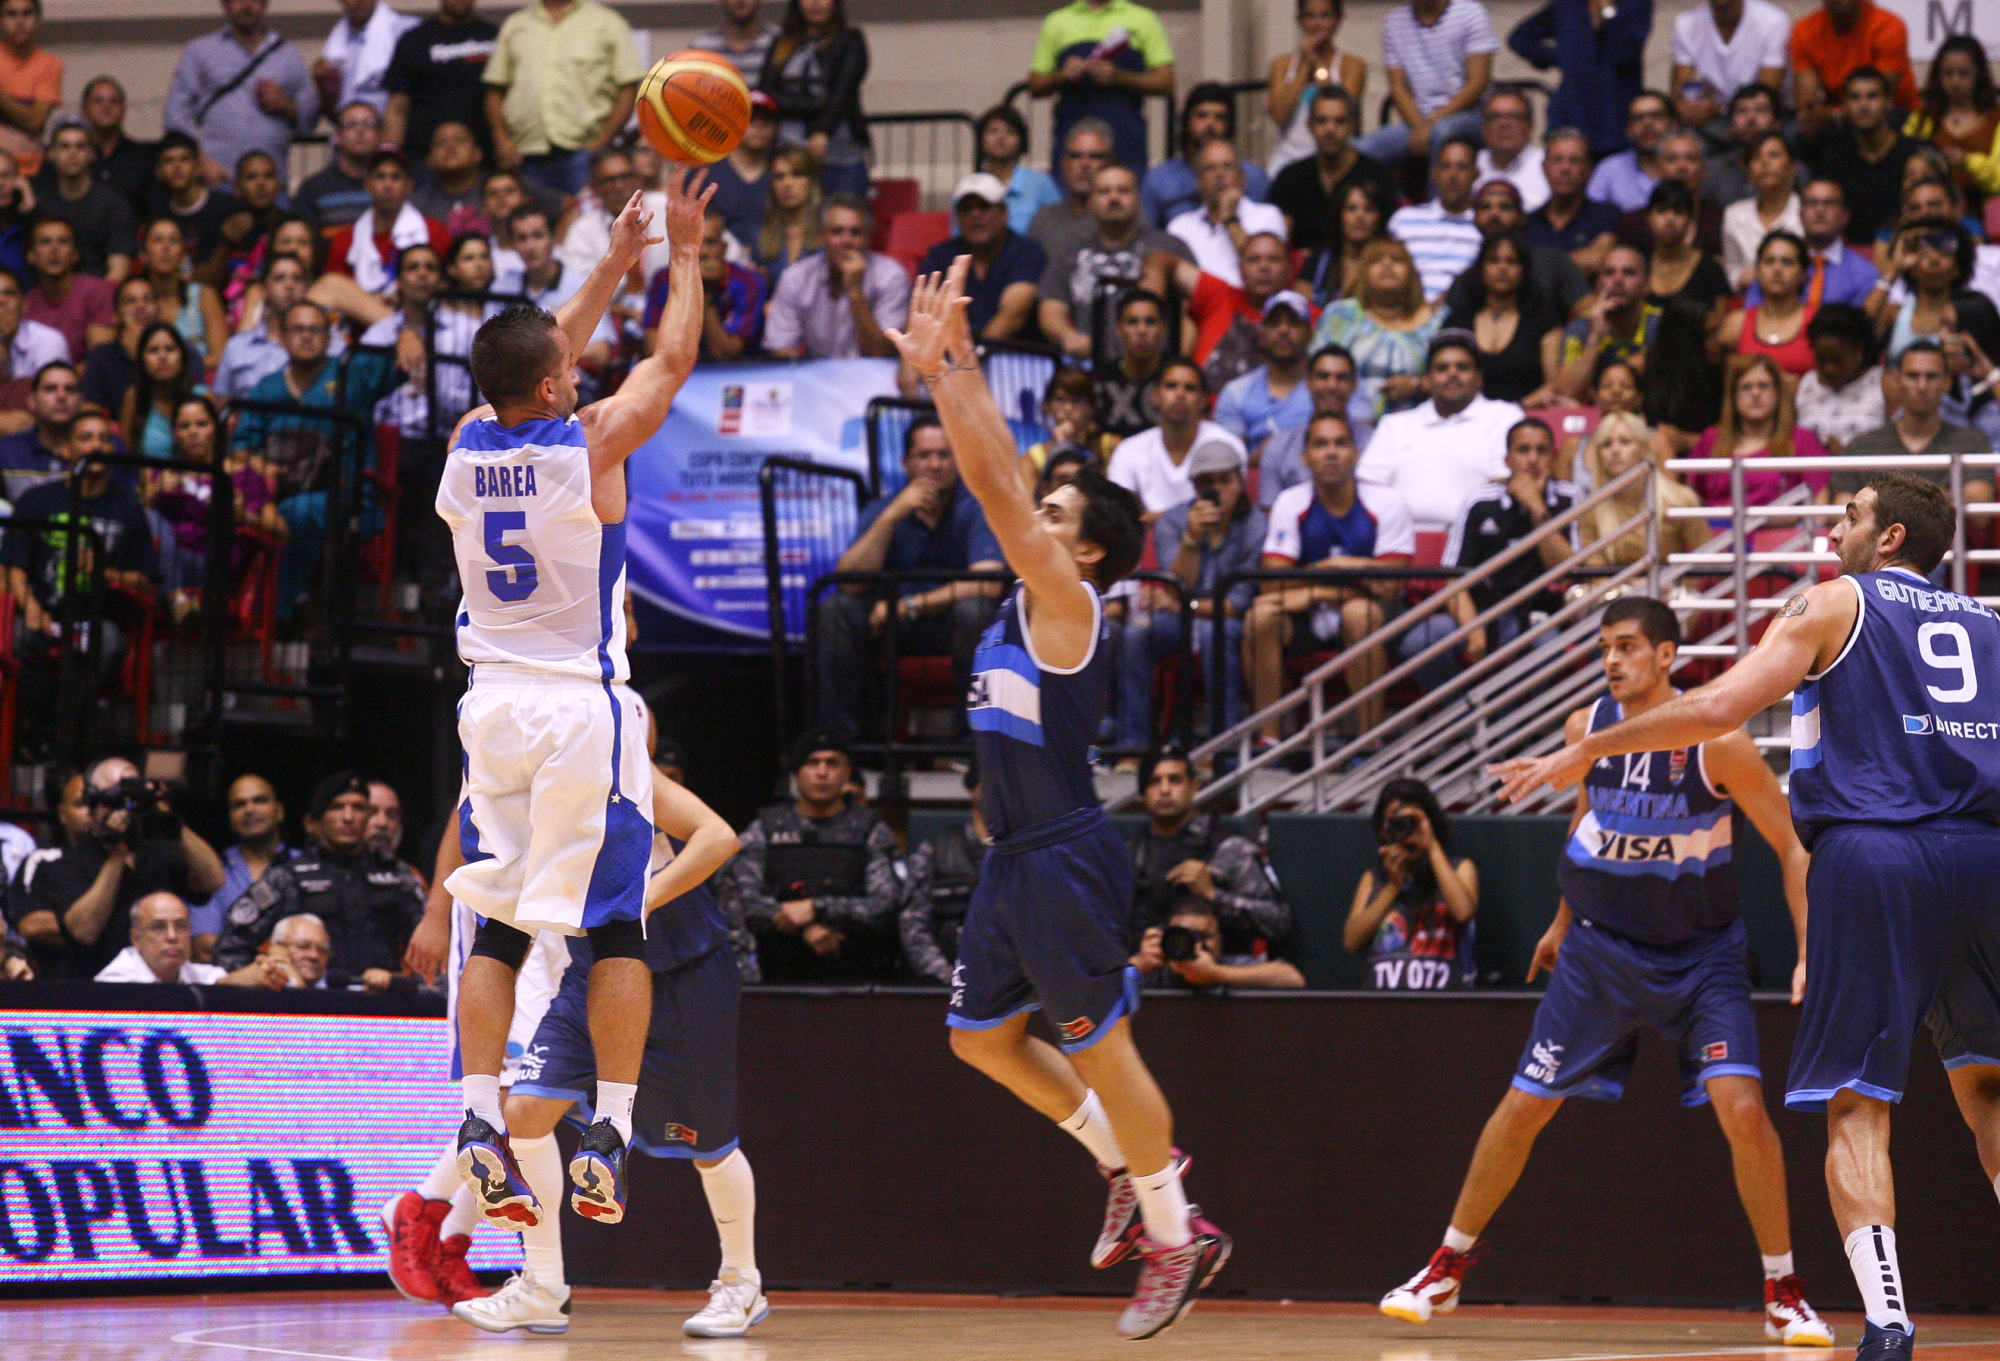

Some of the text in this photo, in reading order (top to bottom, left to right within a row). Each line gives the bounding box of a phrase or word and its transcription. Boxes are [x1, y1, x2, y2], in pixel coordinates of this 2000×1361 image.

[474, 465, 537, 497] BAREA
[484, 511, 538, 602] 5
[1917, 621, 1978, 703] 9
[966, 674, 991, 708] SA
[1935, 714, 2000, 740] DIRECT
[1621, 752, 1652, 791] 14
[1597, 831, 1676, 860] VISA
[1374, 959, 1404, 989] TV
[0, 1029, 211, 1131] NCO
